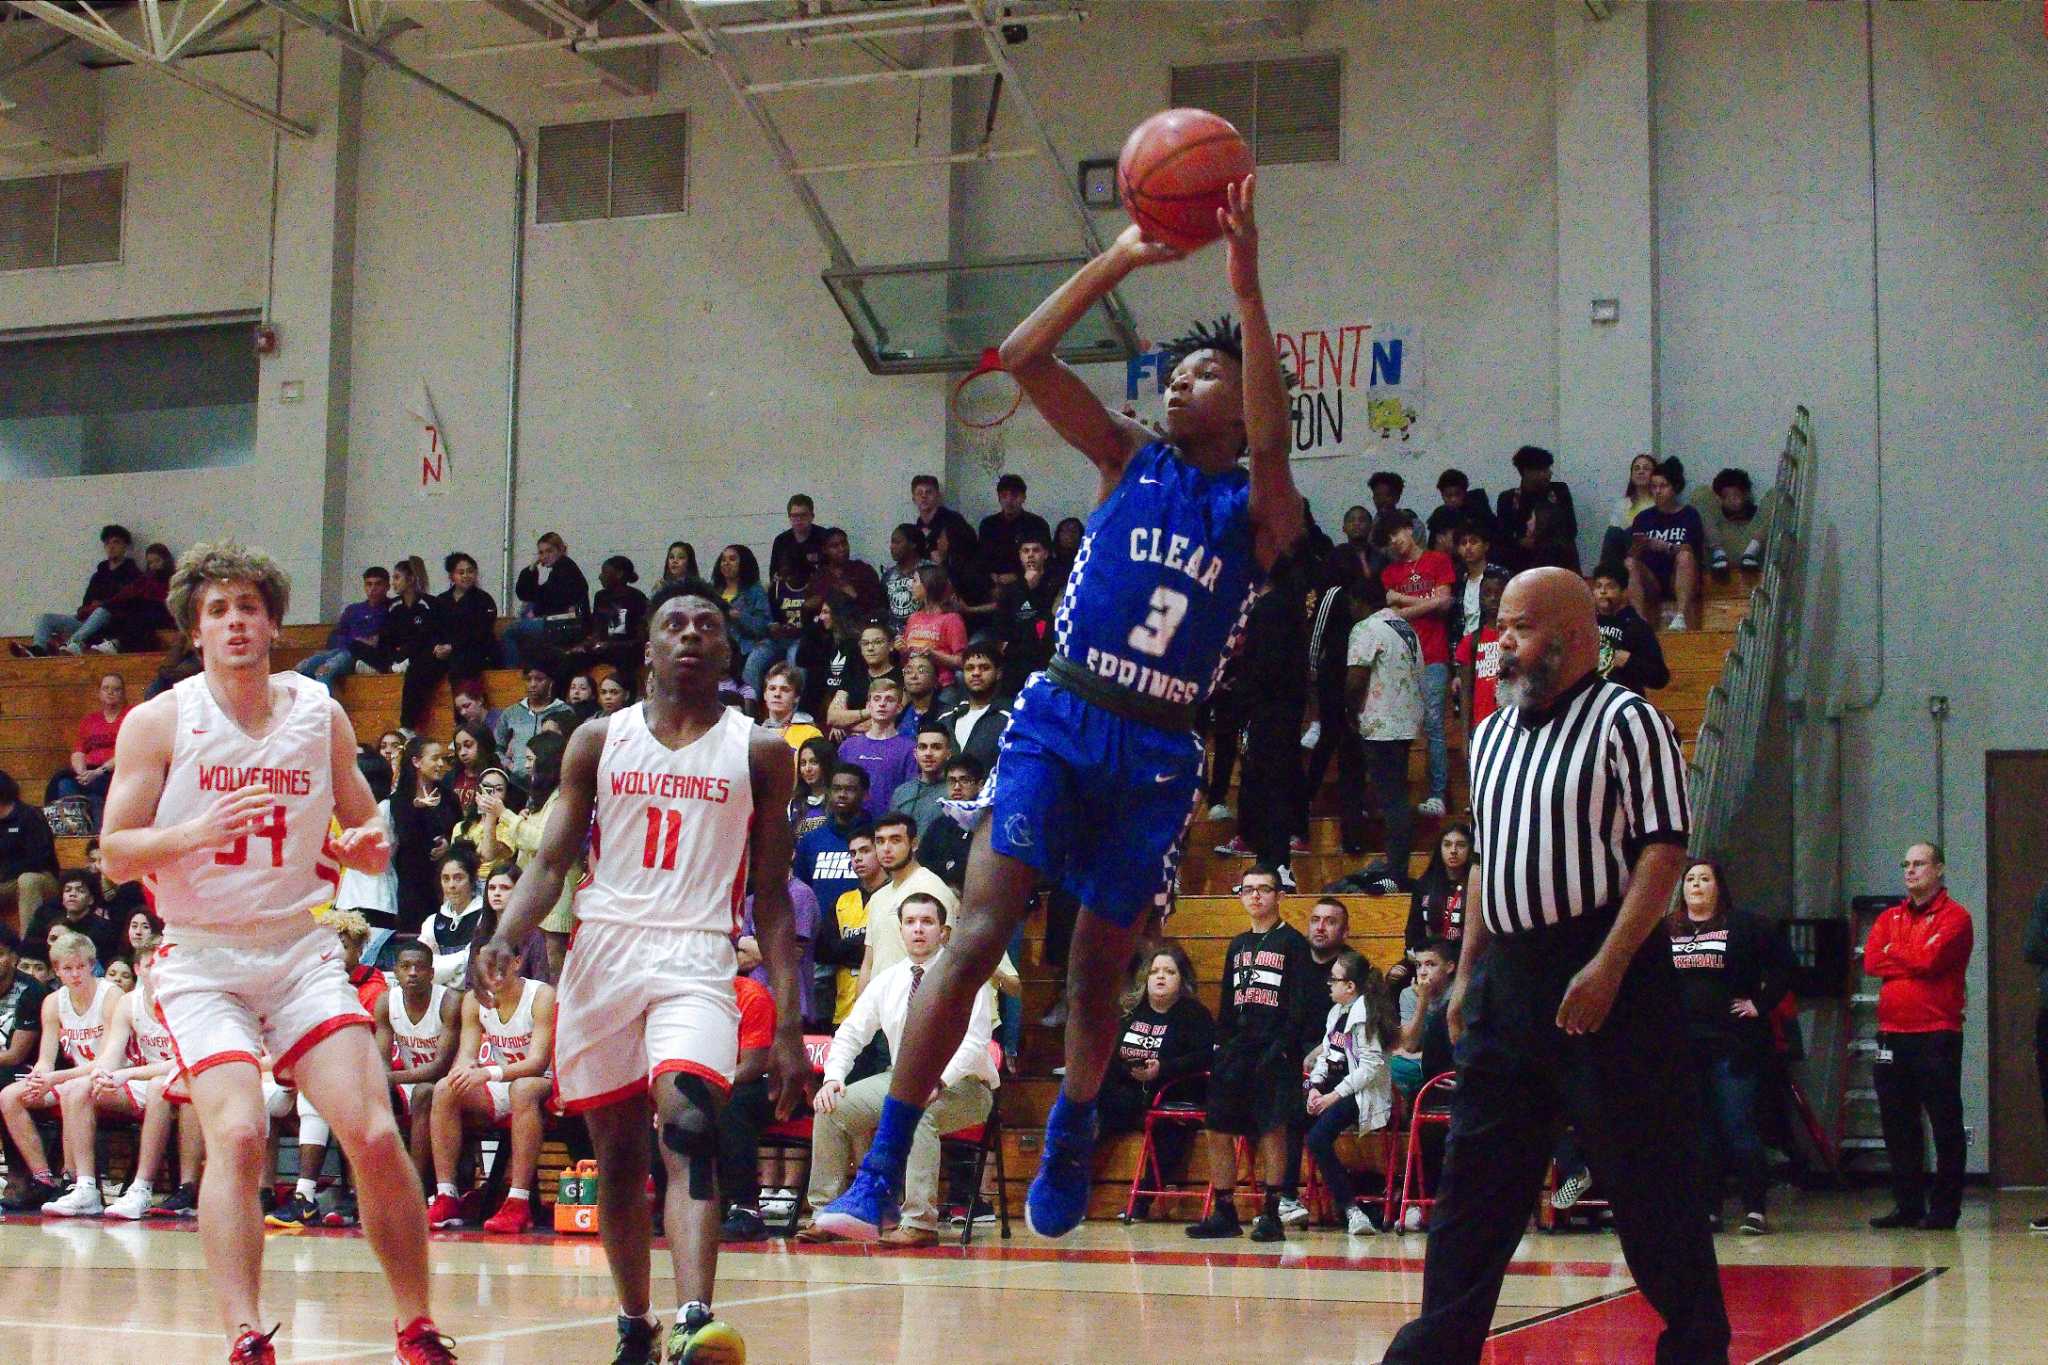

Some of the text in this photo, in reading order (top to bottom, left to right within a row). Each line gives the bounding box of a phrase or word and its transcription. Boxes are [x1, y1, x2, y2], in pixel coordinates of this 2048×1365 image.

[1276, 325, 1372, 390] DENT
[1129, 527, 1223, 592] CLEAR
[1127, 585, 1189, 658] 3
[1086, 647, 1200, 705] SPRINGS
[198, 764, 311, 795] WOLVERINES
[611, 771, 730, 804] WOLVERINES
[643, 806, 682, 871] 11
[812, 851, 859, 879] NIK
[575, 1209, 593, 1229] G
